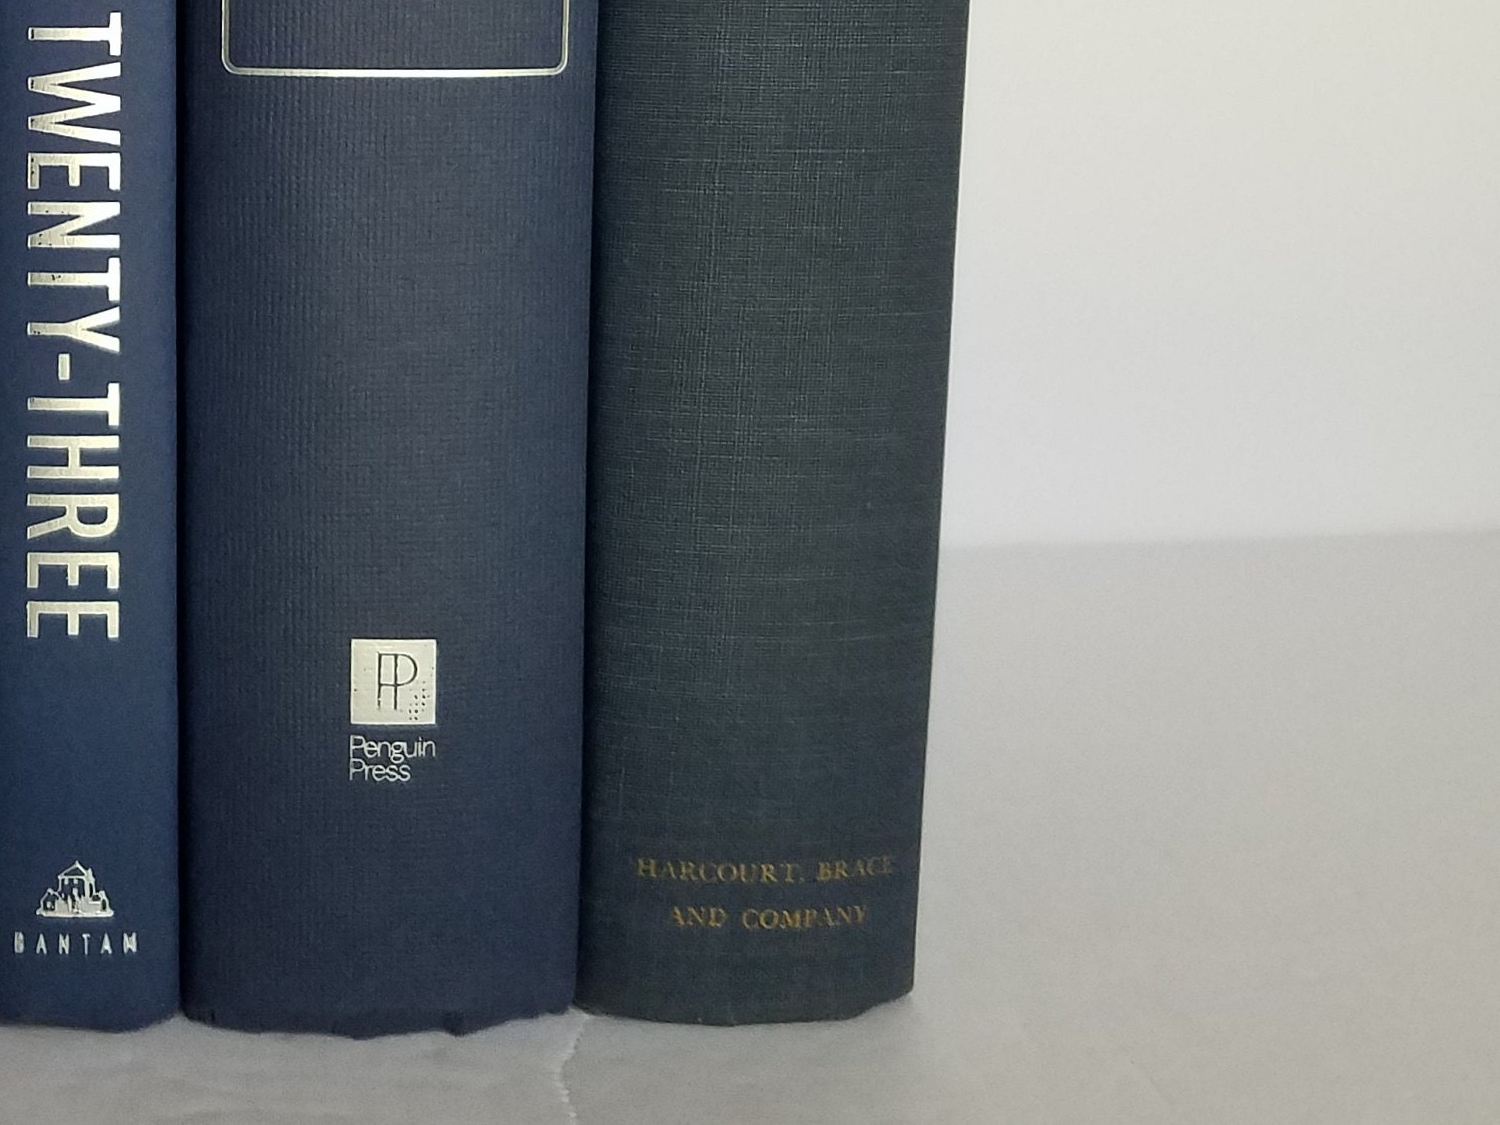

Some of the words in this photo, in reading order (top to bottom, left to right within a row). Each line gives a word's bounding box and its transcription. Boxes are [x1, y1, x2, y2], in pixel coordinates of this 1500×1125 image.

[26, 11, 122, 639] TWENTY-THREE
[350, 735, 436, 763] Penguin
[350, 758, 411, 782] Press
[670, 905, 728, 928] AND
[742, 904, 868, 930] COMPANY
[13, 931, 139, 955] BANTAM
